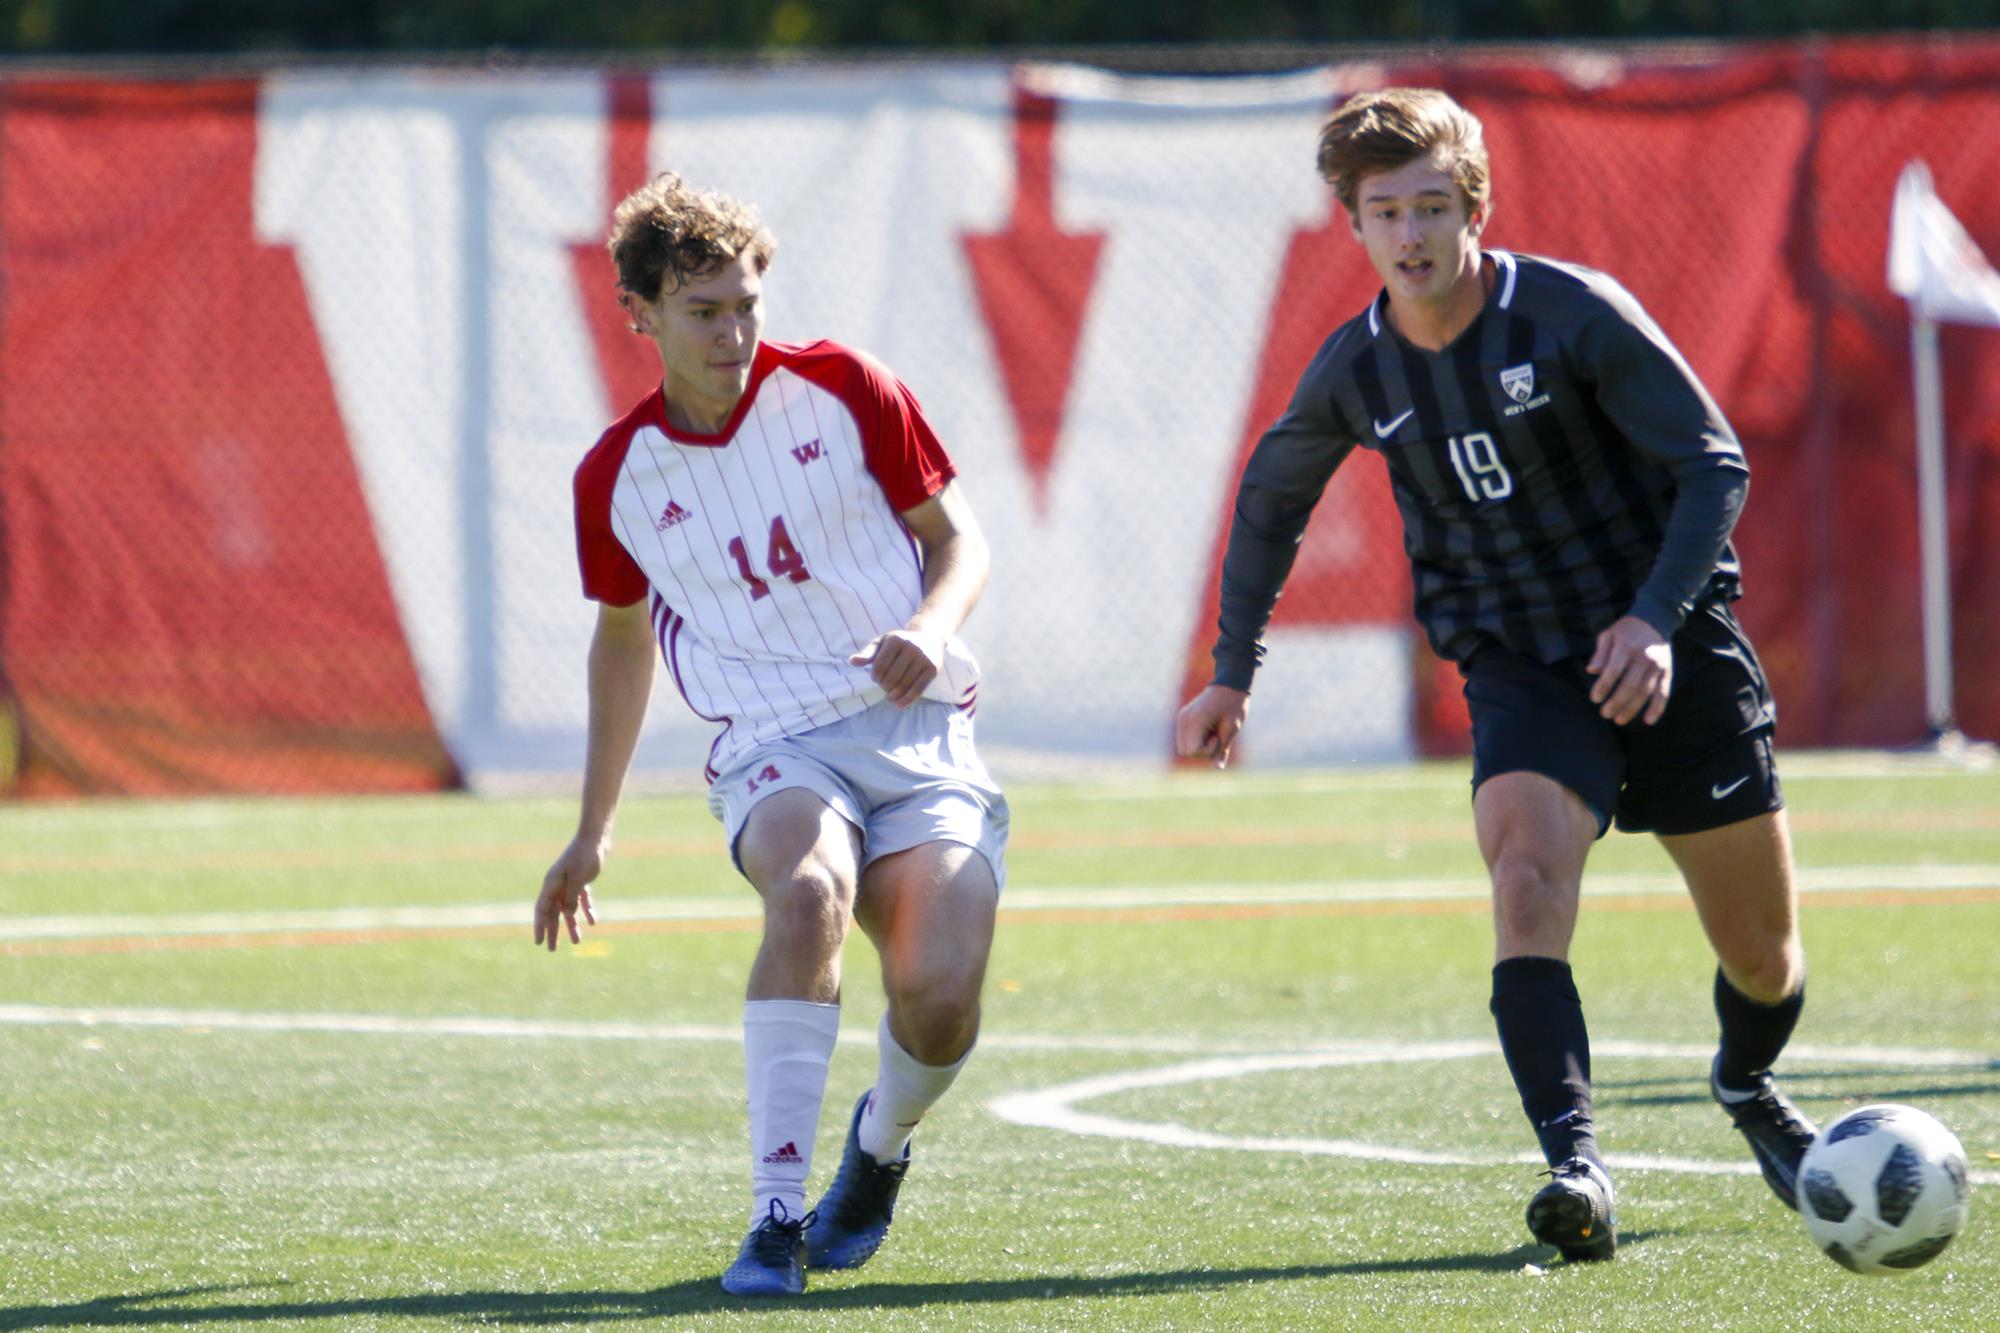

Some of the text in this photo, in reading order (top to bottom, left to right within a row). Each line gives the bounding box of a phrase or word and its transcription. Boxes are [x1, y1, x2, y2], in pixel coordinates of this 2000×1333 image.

[1448, 432, 1512, 502] 19
[728, 515, 811, 602] 14
[746, 764, 781, 796] 14
